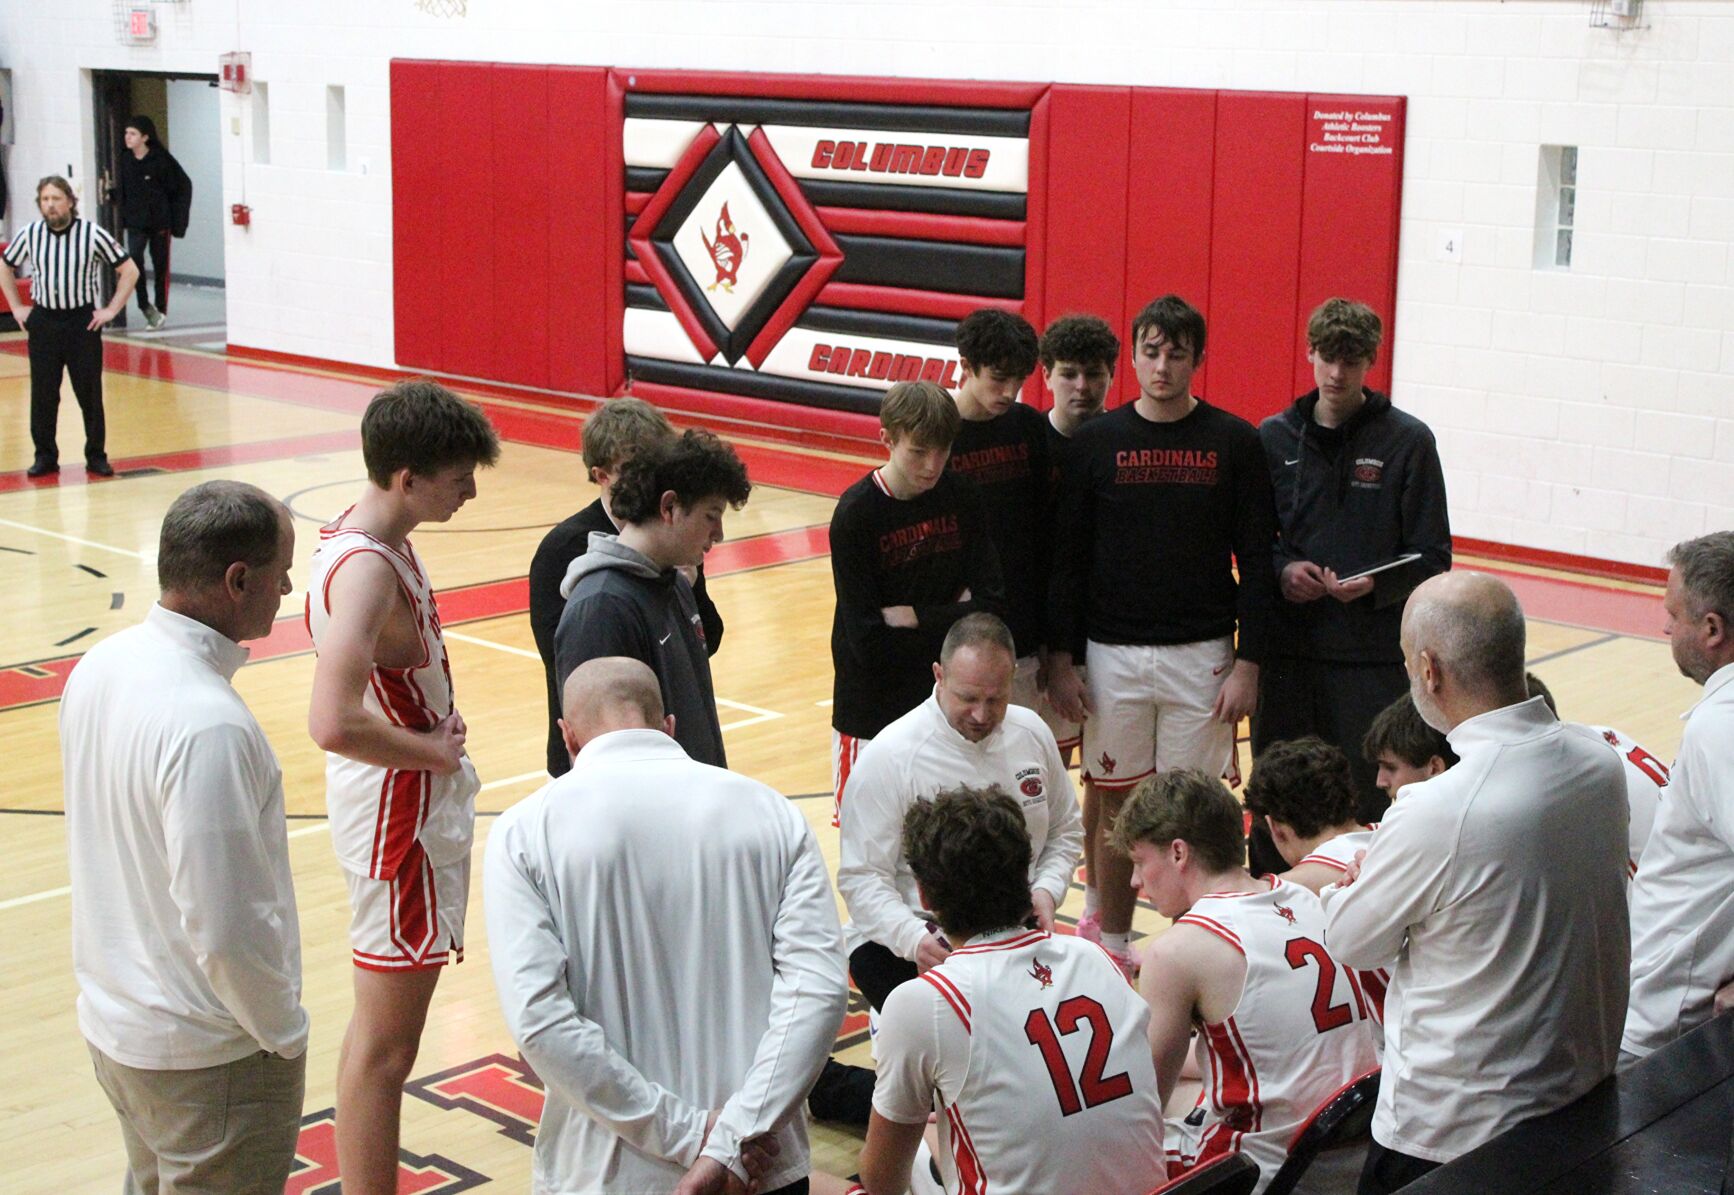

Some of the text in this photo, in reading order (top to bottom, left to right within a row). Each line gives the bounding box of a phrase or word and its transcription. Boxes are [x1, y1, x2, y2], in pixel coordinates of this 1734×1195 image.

[1313, 110, 1392, 122] Donated by Columbus
[1321, 122, 1382, 132] Athletic Boosters
[1323, 132, 1379, 143] Backcourt Club
[811, 139, 991, 179] COLUMBUS
[1310, 143, 1392, 155] Courtside Organization
[1445, 239, 1454, 253] 4
[808, 343, 967, 390] CARDINAL
[952, 442, 1029, 473] CARDINALS
[1116, 449, 1218, 469] CARDINALS
[879, 514, 958, 552] CARDINALS
[1023, 994, 1134, 1117] 12
